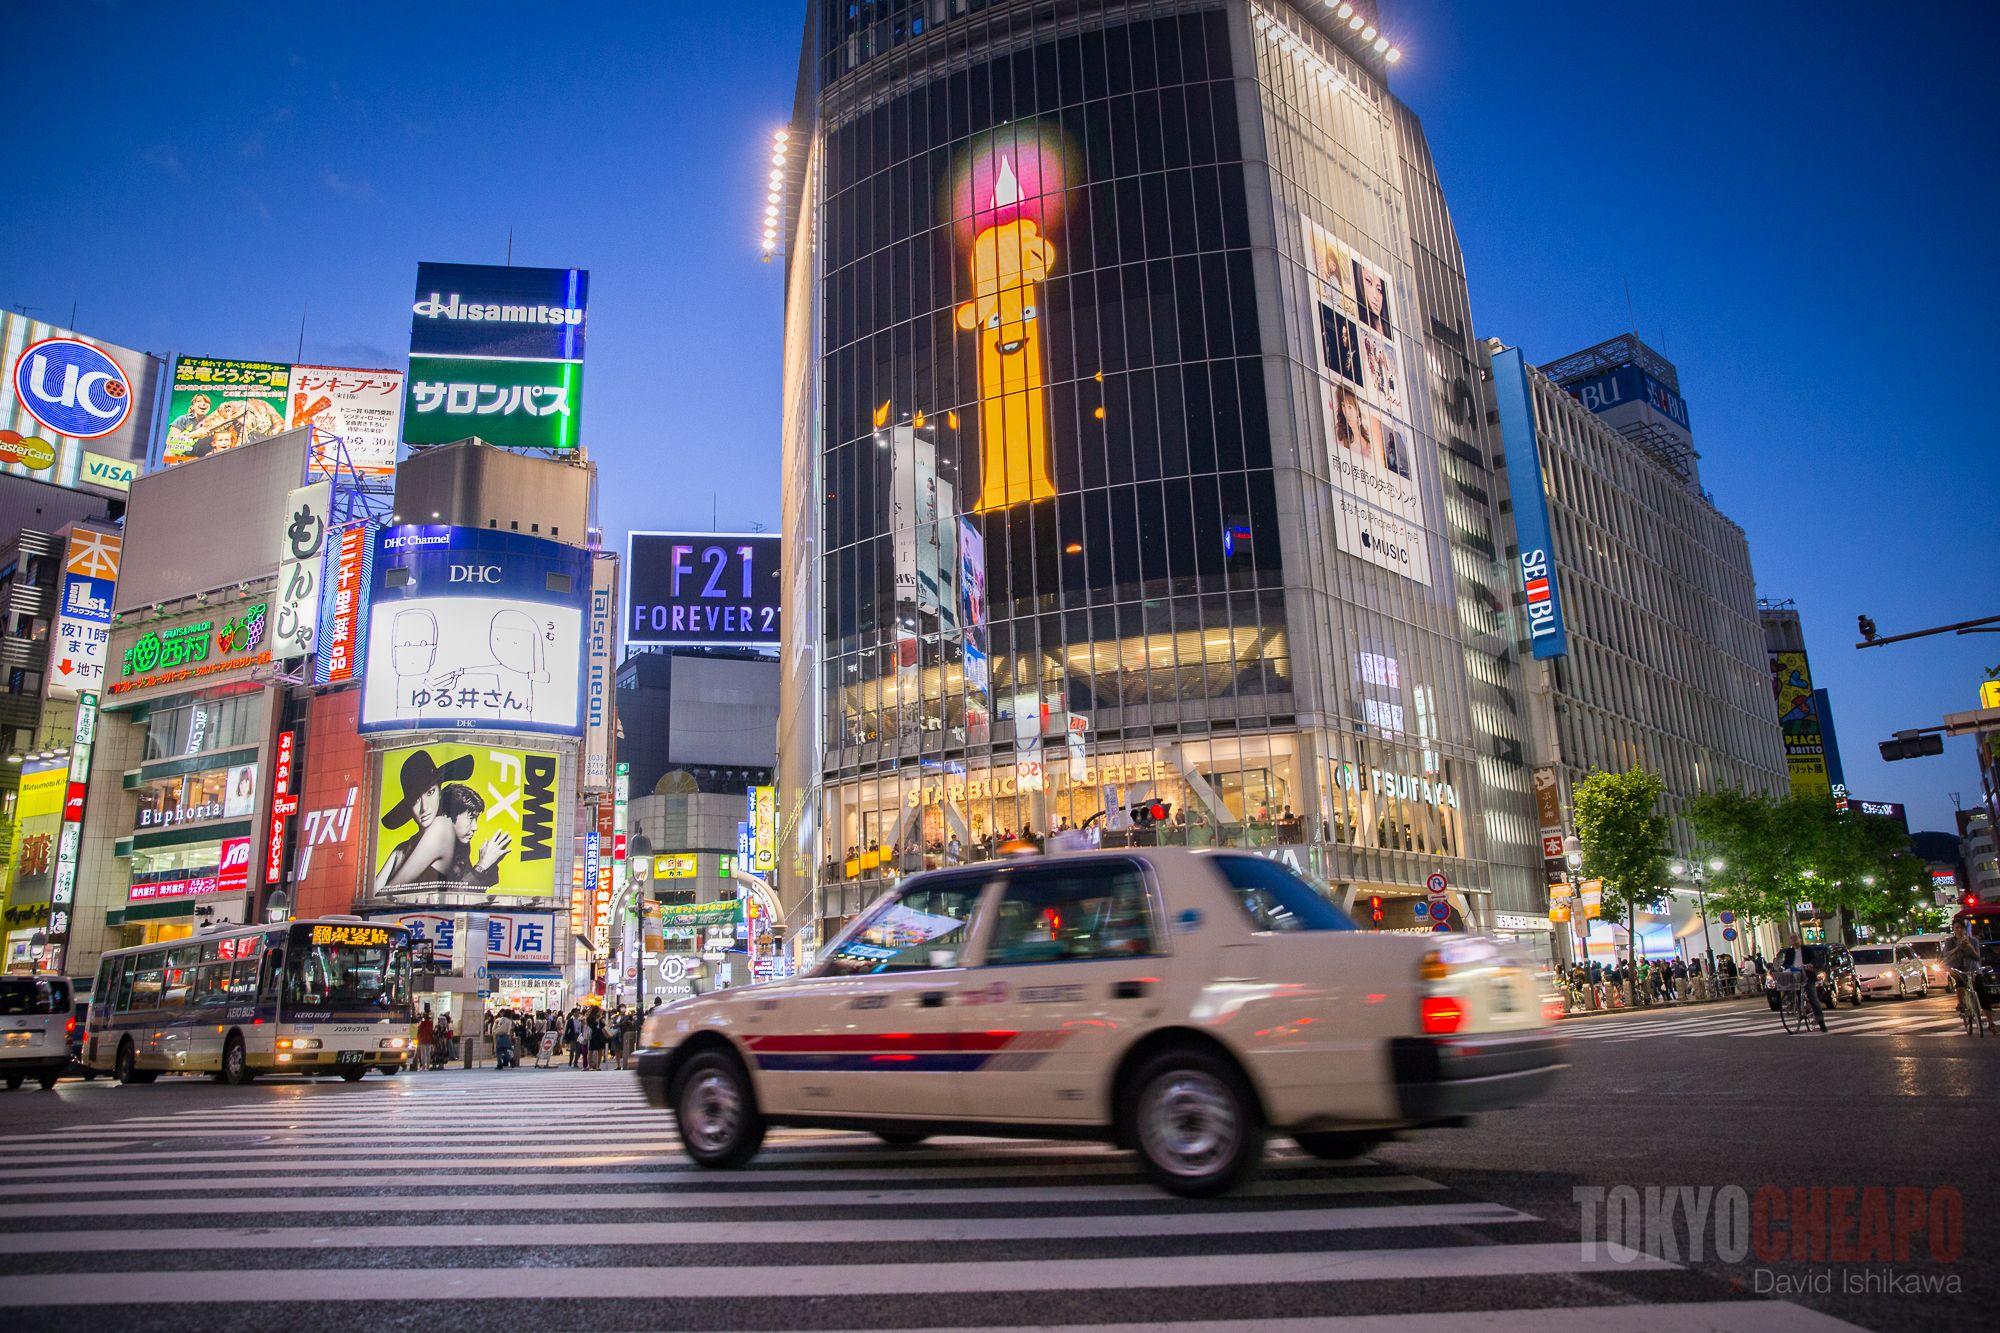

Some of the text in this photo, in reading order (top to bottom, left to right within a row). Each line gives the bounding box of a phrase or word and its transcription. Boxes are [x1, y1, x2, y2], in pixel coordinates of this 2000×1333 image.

[413, 293, 582, 325] Hisamitsu
[29, 354, 125, 419] UC
[176, 365, 289, 387] 恐竜どうぶつ園
[296, 375, 399, 396] キンキーブーツ
[413, 381, 571, 417] サロンパス
[0, 440, 55, 463] asterCard
[90, 462, 133, 483] VISA
[384, 533, 450, 549] DHC Channel
[1372, 535, 1408, 565] MUSIC
[67, 533, 120, 578] 本
[276, 503, 325, 650] もんじゃ
[449, 565, 502, 584] DHC
[670, 545, 754, 598] F21
[329, 533, 358, 671] 三千里薬品
[1521, 549, 1557, 640] SEIBU
[66, 606, 110, 619] ブックファースト
[634, 605, 753, 632] FOREVER
[61, 622, 108, 643] 夜11時
[68, 640, 97, 656] まで
[160, 633, 210, 668] 西村
[589, 583, 611, 728] Taisei neon
[76, 661, 104, 678] 地下
[411, 688, 523, 710] ゆる井さん
[456, 719, 477, 728] DHC
[1785, 734, 1821, 745] PEACE
[1790, 746, 1823, 755] BRITTO
[588, 754, 604, 762] (03)
[486, 750, 522, 823] FX
[1370, 769, 1458, 809] TSUTAYA
[140, 802, 222, 827] Euphoria
[304, 786, 358, 846] クスリ
[520, 754, 557, 862] DMM
[221, 842, 250, 870] JTB
[1545, 838, 1561, 855] 本
[227, 1006, 255, 1018] KEIO BUS
[294, 1011, 332, 1019] KEIO BUS
